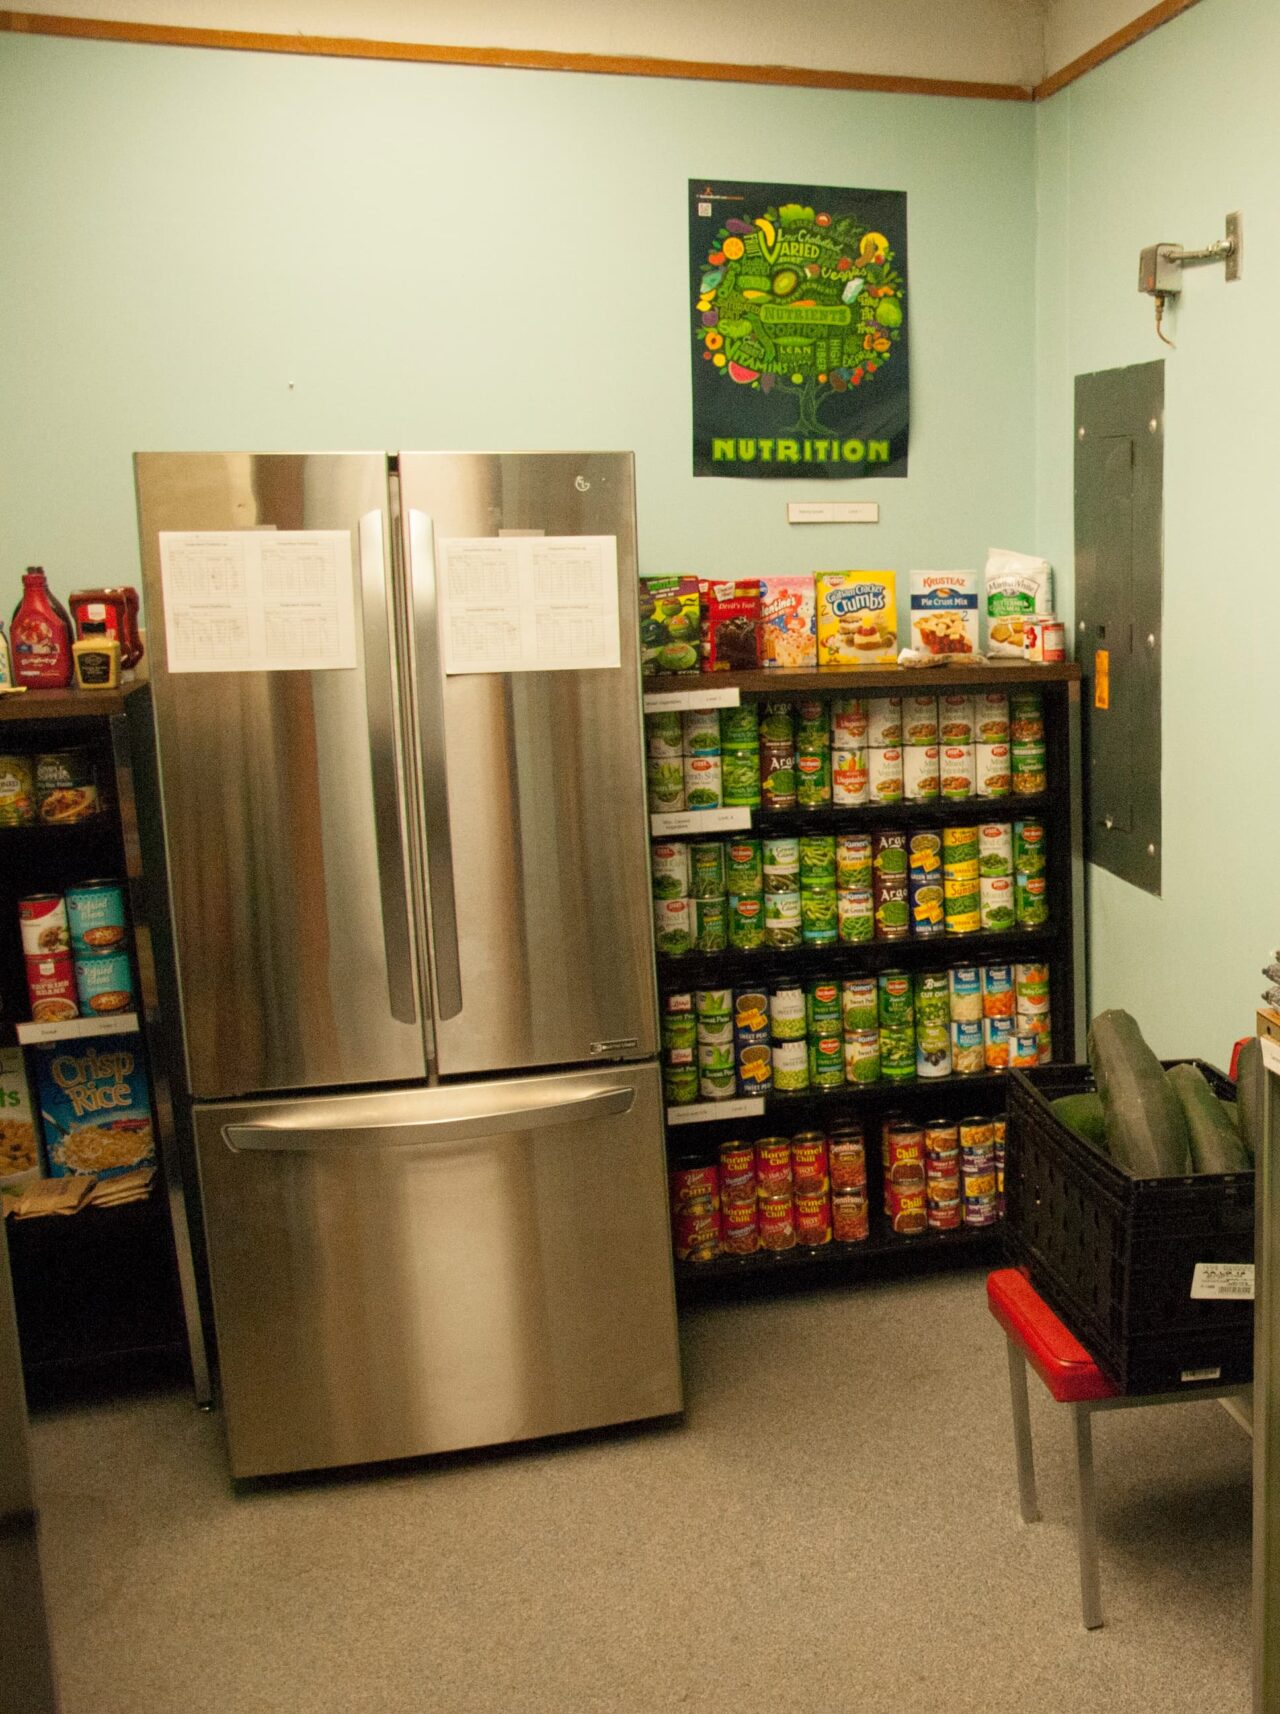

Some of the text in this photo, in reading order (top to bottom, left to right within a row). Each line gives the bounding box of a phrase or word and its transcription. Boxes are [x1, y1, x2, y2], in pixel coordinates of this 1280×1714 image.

[759, 228, 820, 264] VARIED
[821, 266, 867, 281] Veggies
[764, 307, 847, 321] NUTRIENTS
[711, 437, 890, 464] NUTRITION
[923, 576, 965, 588] KRUSTEAZ
[718, 602, 741, 610] Devil's
[832, 593, 885, 616] Crumbs
[921, 598, 968, 606] Pie Crust Mix
[961, 611, 970, 622] 2
[52, 1048, 134, 1088] Crisp
[65, 1082, 132, 1116] Rice
